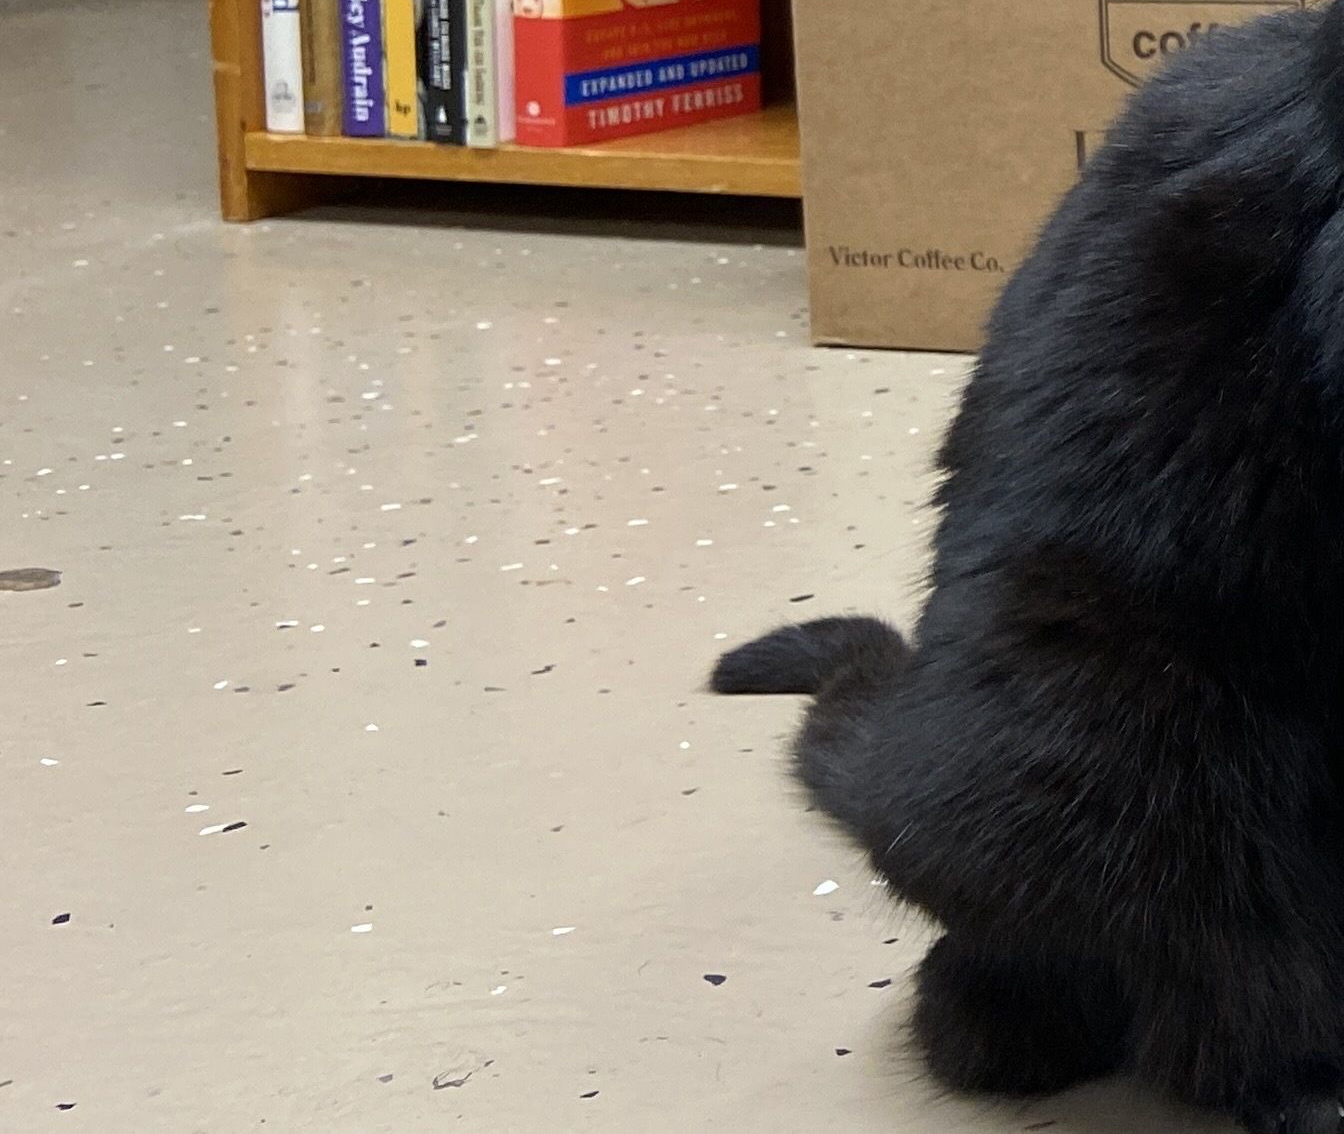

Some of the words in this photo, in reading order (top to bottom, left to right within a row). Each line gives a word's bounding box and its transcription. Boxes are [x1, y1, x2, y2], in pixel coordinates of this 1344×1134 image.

[581, 69, 653, 97] EXPANDED
[659, 64, 685, 83] AND
[691, 53, 749, 79] UPDATED
[587, 98, 665, 129] TIMOTHY
[672, 84, 744, 113] FERRISS
[829, 246, 891, 268] Victor
[897, 248, 965, 271] Coffee
[970, 250, 1006, 274] Co.
